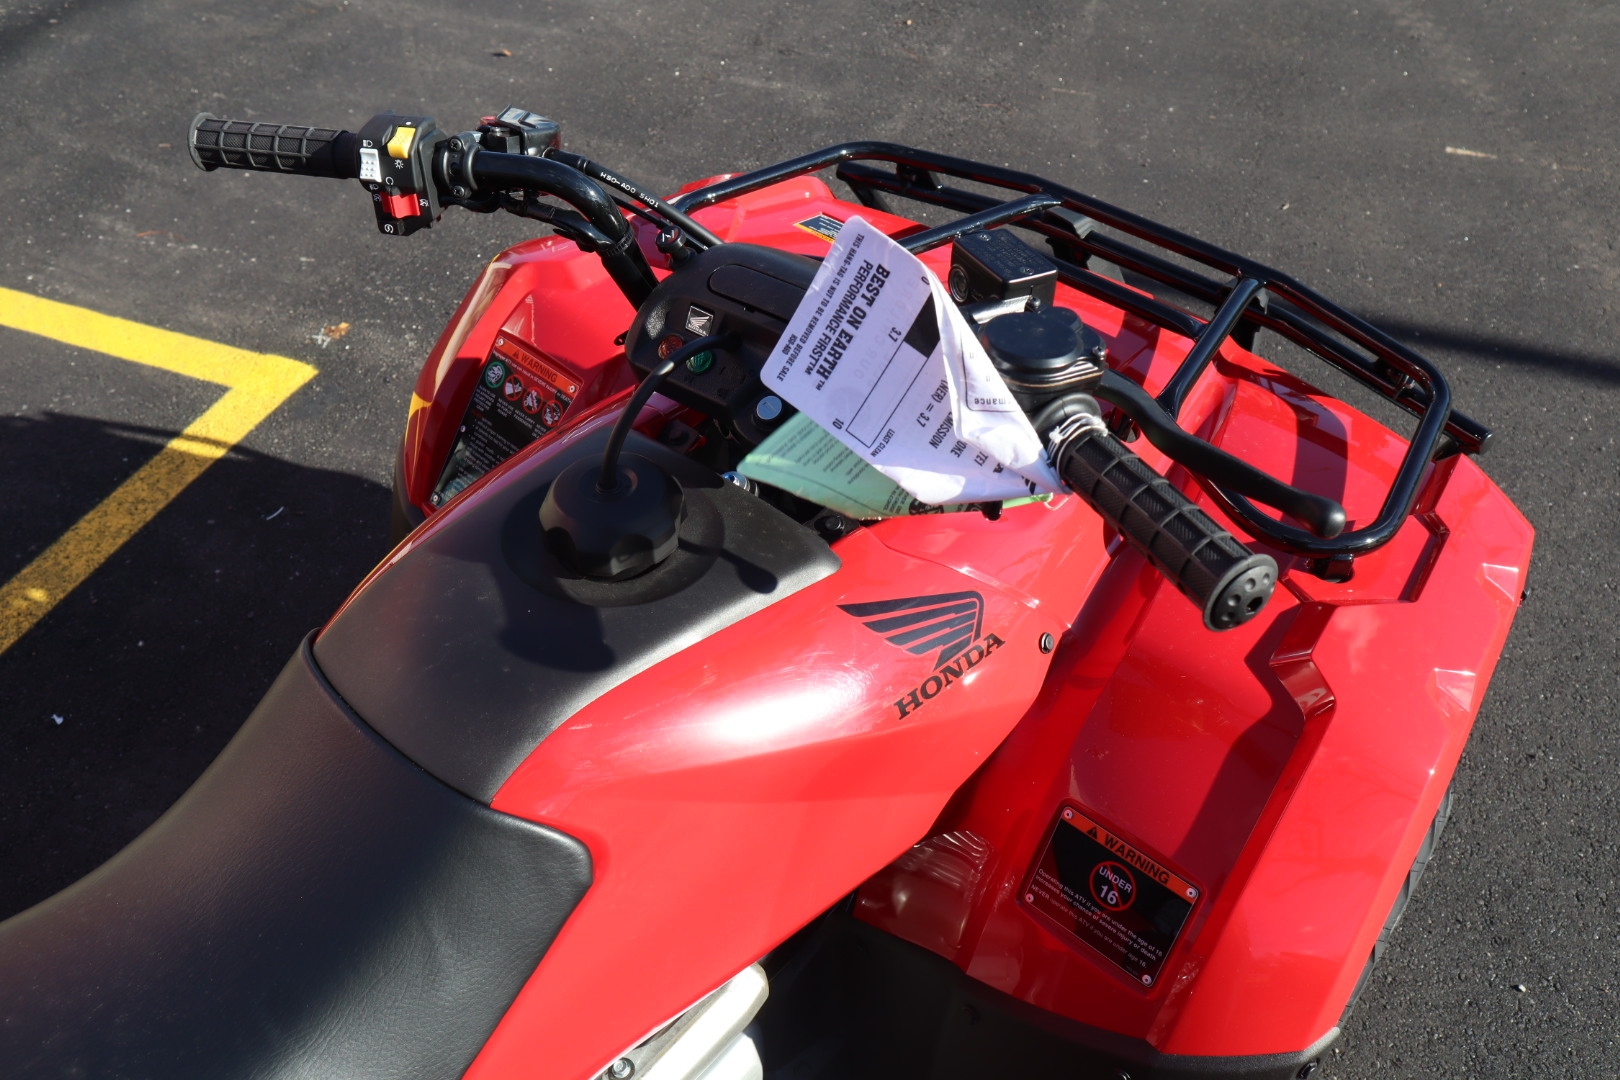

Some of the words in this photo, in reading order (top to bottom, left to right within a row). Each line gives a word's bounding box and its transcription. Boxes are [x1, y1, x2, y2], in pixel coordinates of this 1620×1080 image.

[852, 233, 864, 248] THIS
[837, 248, 856, 277] HANG-TAG
[832, 277, 841, 286] IS
[861, 264, 890, 306] BEST
[825, 285, 836, 298] NOT
[826, 260, 873, 334] PERFORMANCE
[815, 306, 824, 316] BE
[820, 298, 829, 307] TO
[847, 306, 866, 330] ON
[799, 316, 818, 344] REMOVED
[888, 327, 901, 342] 3.7
[786, 343, 802, 366] BEFORE
[521, 354, 557, 382] WARNING
[776, 365, 789, 381] SALE
[926, 403, 934, 411] =
[832, 418, 844, 429] 10
[916, 412, 929, 427] 3.7
[882, 428, 895, 444] LEAST
[870, 442, 886, 457] CLEAN
[950, 440, 967, 458] OKE
[894, 633, 1006, 720] HONDA
[1105, 835, 1169, 884] WARNING
[1099, 866, 1132, 892] UNDER
[1099, 885, 1119, 904] 16
[1063, 886, 1074, 896] this
[1074, 894, 1087, 903] ATV
[1090, 905, 1102, 915] you
[1127, 930, 1137, 939] the
